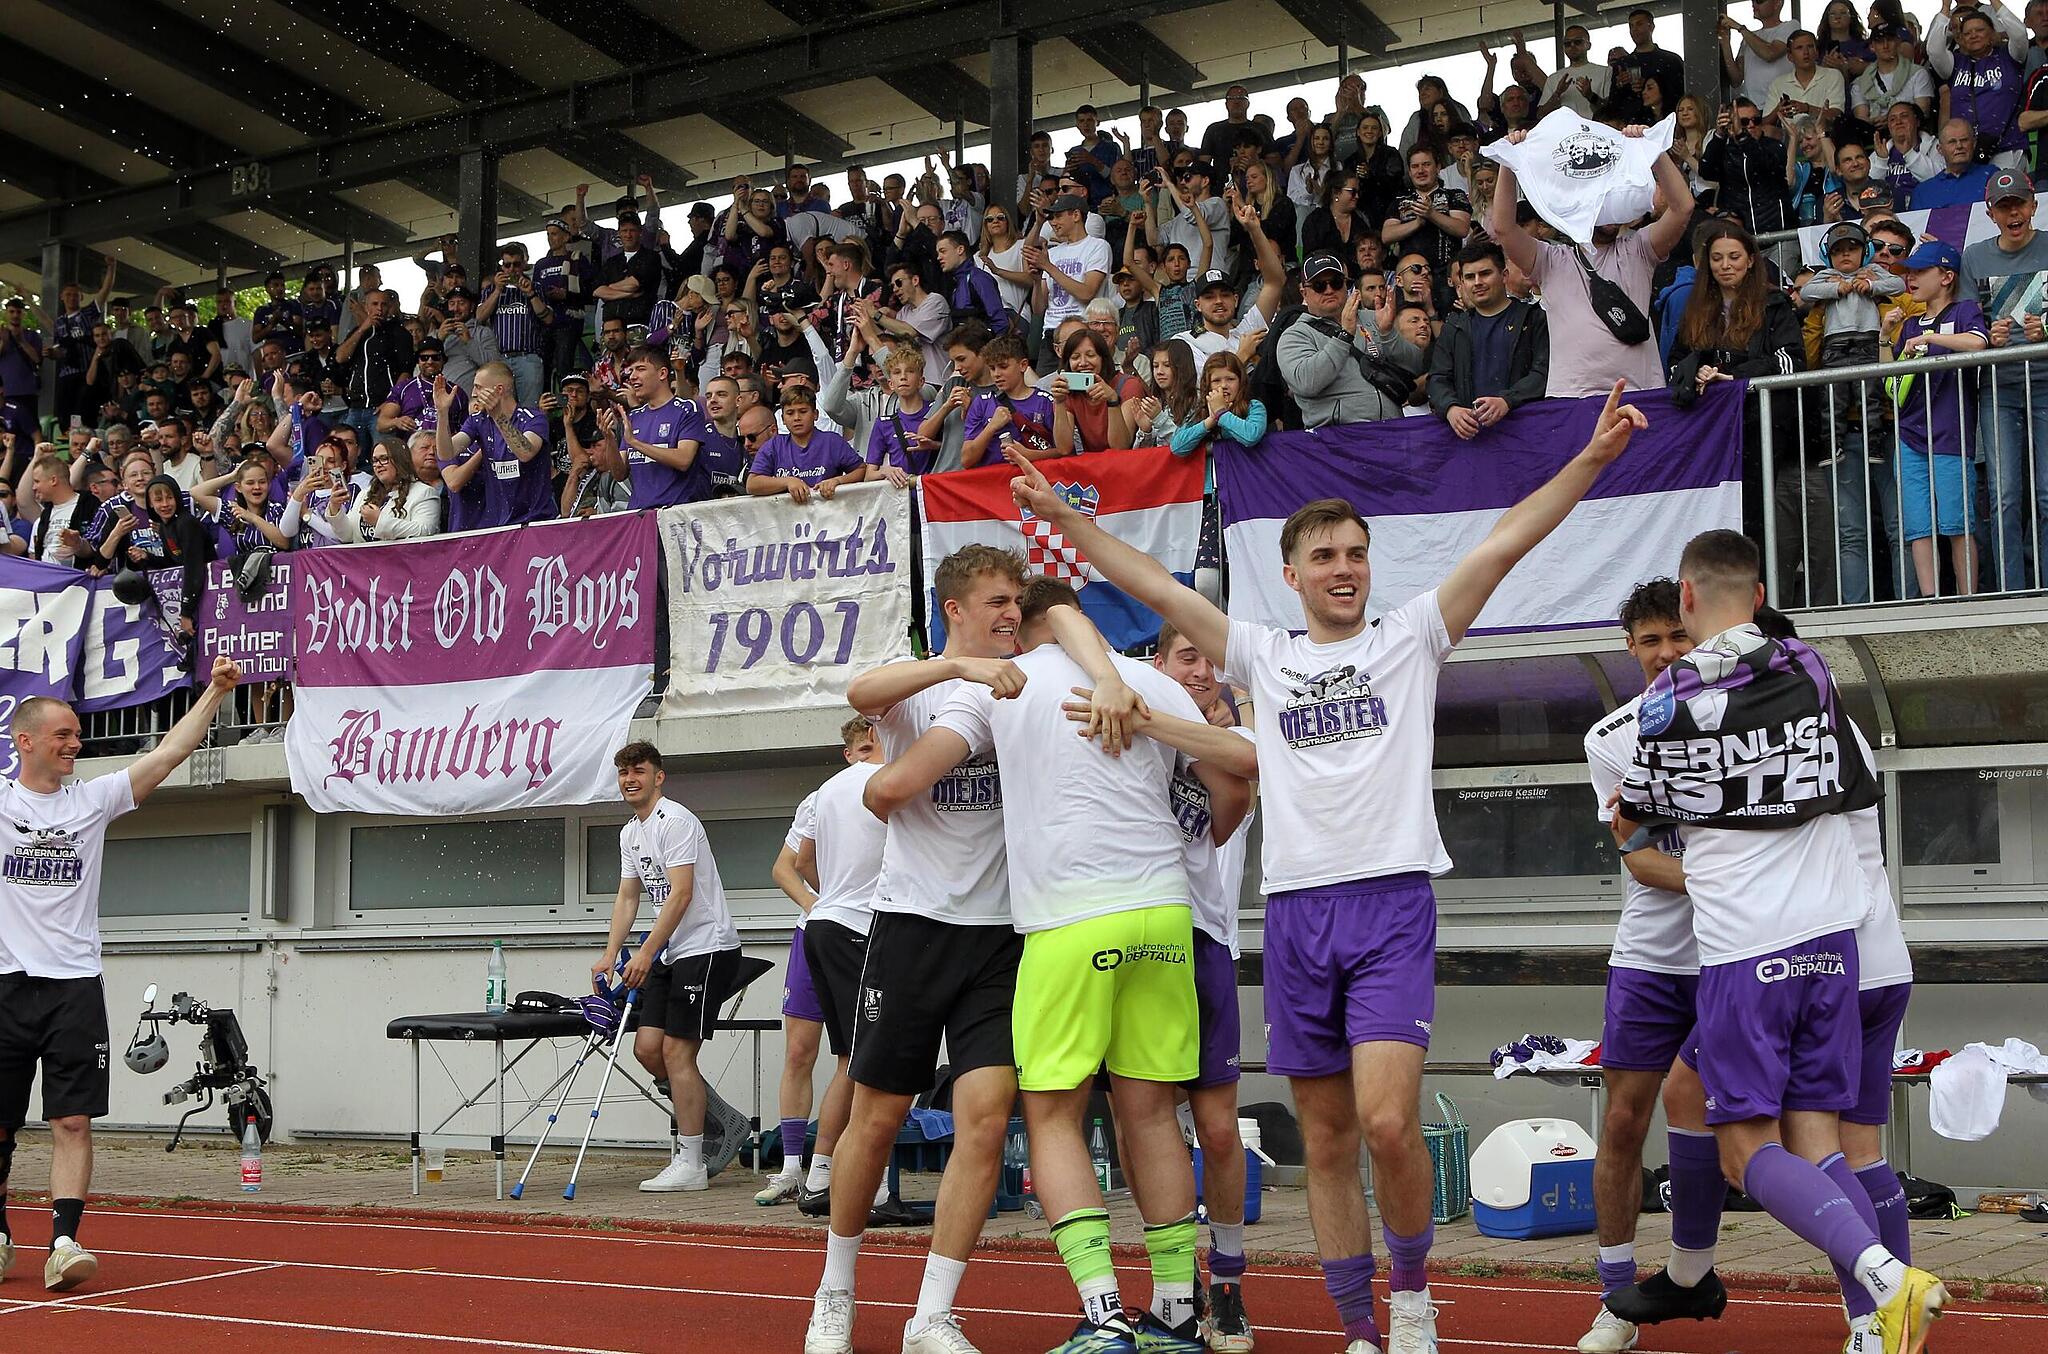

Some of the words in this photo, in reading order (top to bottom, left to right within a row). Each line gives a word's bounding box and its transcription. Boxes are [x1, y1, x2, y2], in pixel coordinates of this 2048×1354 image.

[669, 516, 897, 594] Vorwärts
[304, 573, 414, 655] Violet
[433, 564, 508, 649] Old
[525, 554, 642, 650] Boys
[204, 623, 284, 657] Partner
[256, 653, 289, 673] Tour
[1279, 696, 1389, 742] MEISTER
[323, 703, 563, 792] Bamberg
[1298, 734, 1342, 749] EINTRACHT
[1343, 728, 1382, 741] BAMBERG
[1515, 787, 1549, 797] Kestler
[1725, 802, 1796, 817] AMBERG
[15, 847, 77, 859] BAYERNLIGA
[3, 855, 82, 881] MEISTER
[1125, 951, 1186, 964] DEPTALLA
[98, 1053, 106, 1069] 15
